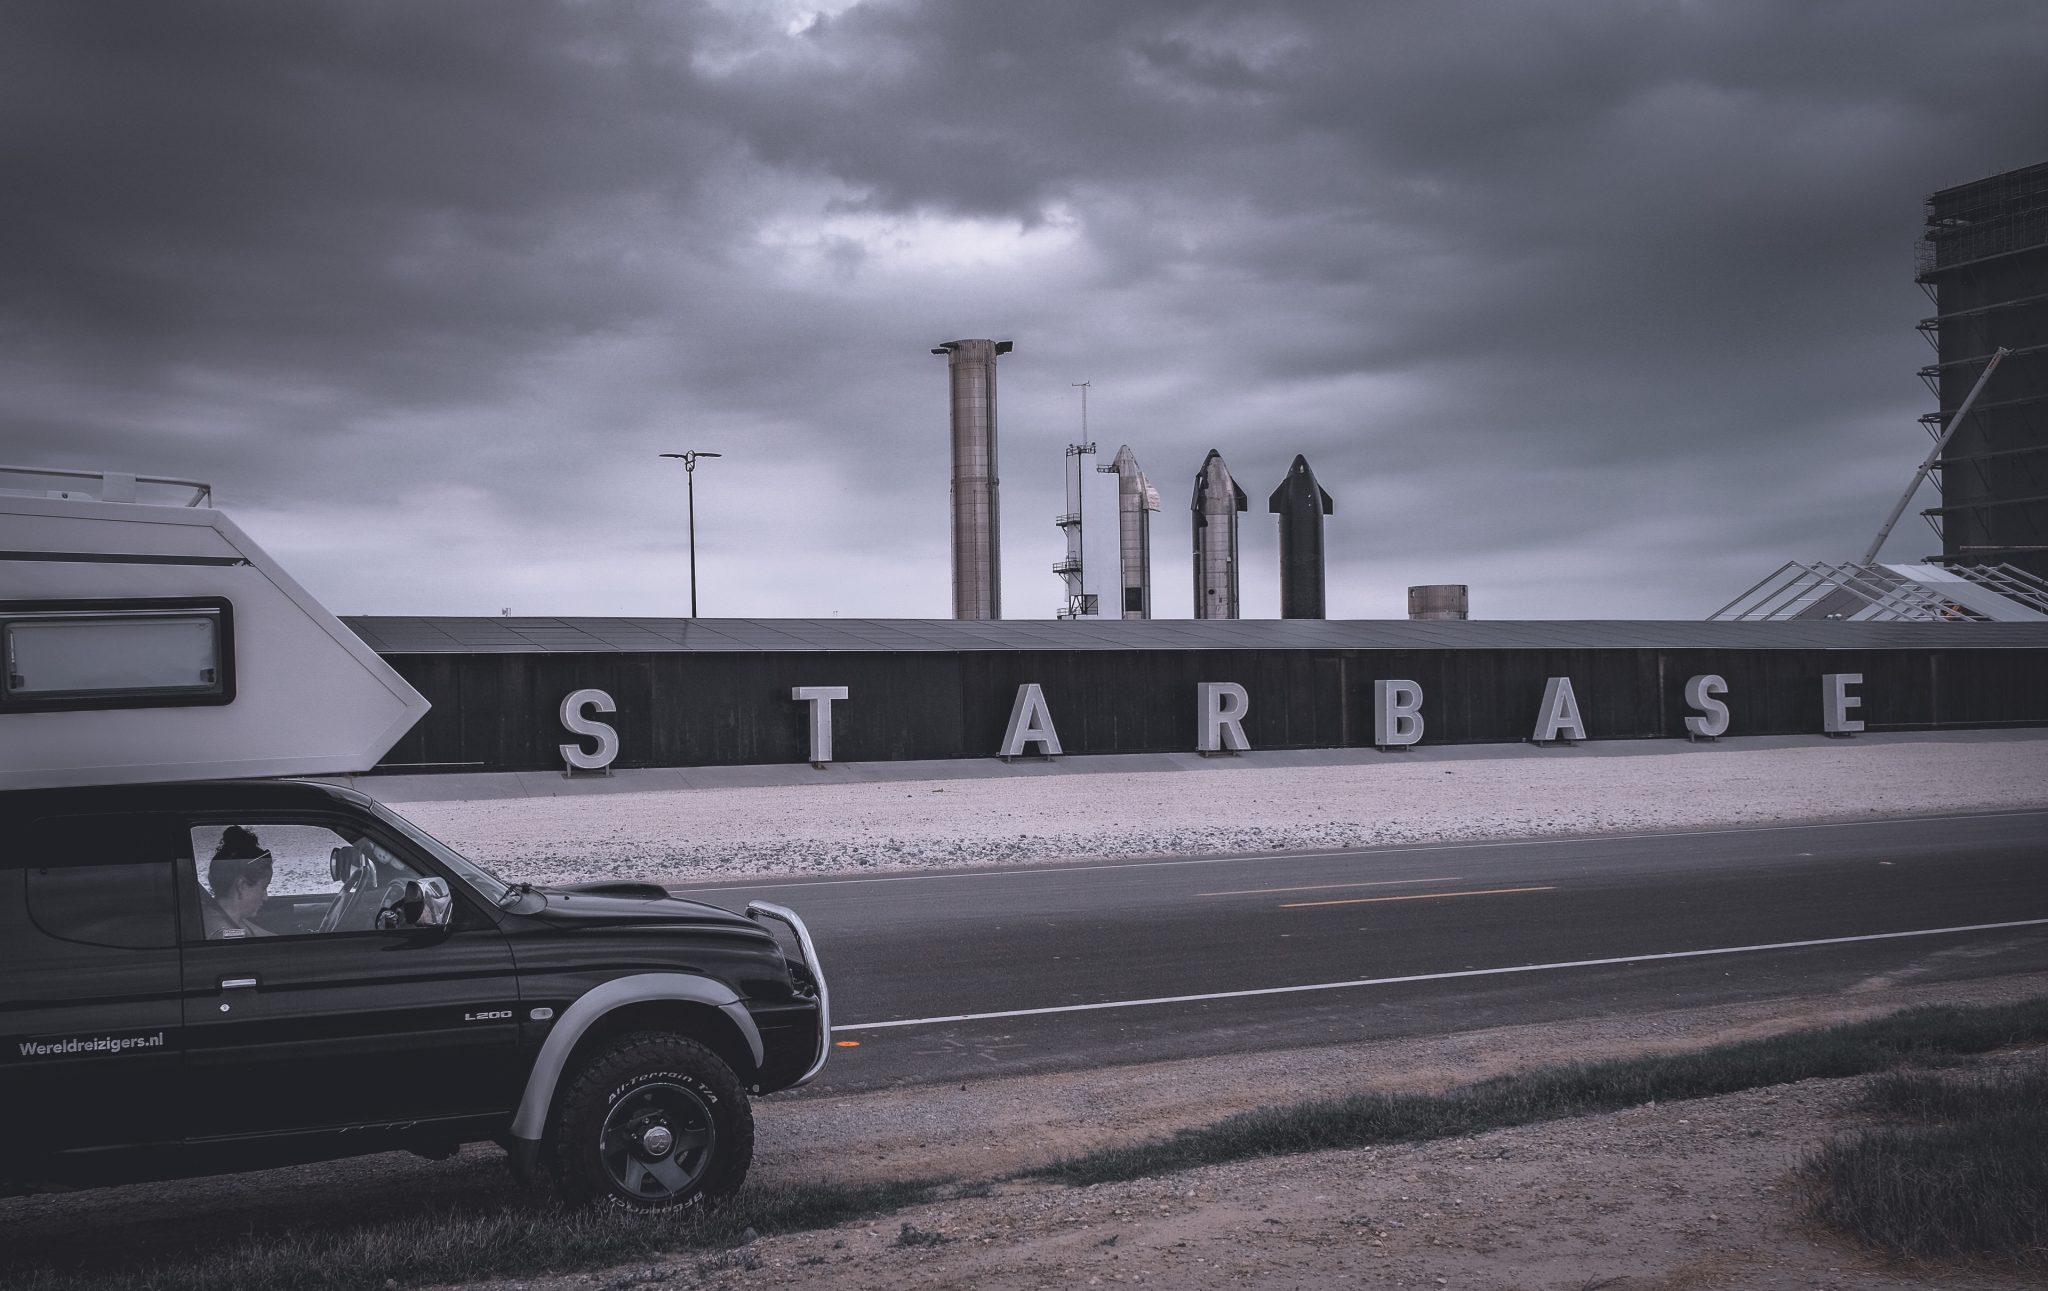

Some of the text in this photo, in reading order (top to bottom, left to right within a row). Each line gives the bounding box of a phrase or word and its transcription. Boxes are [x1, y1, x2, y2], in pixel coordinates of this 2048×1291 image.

[559, 673, 1866, 770] STARBASE
[465, 1010, 512, 1021] L200
[19, 1032, 164, 1056] Wereldreizigers.nl
[608, 1071, 718, 1104] All-Terrain T/A
